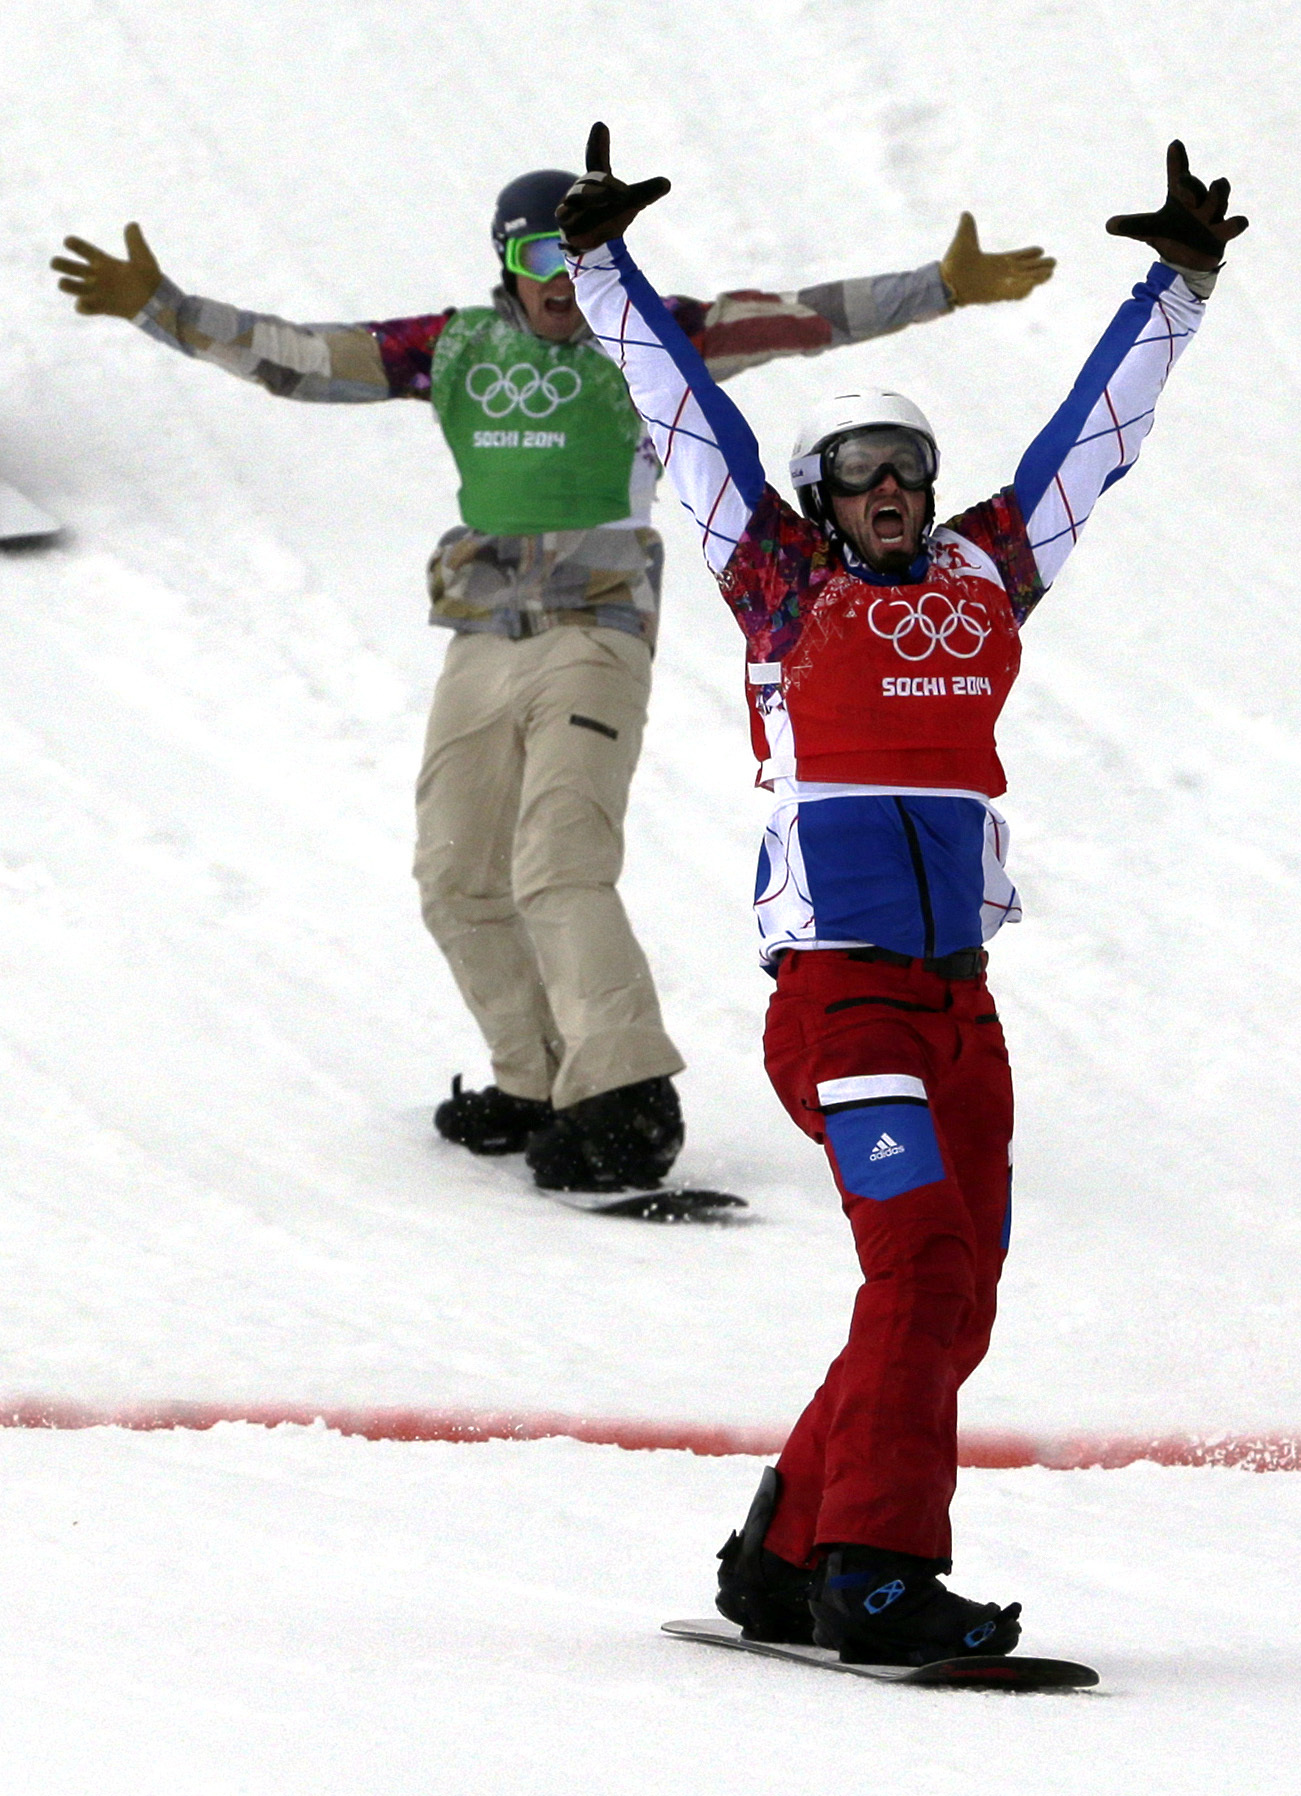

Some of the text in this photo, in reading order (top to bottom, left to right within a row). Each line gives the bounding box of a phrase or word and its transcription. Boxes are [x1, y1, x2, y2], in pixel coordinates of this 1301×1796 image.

[473, 430, 567, 448] SOCHI 2014
[881, 676, 992, 697] SOCHI 2014
[869, 1145, 905, 1161] adidas
